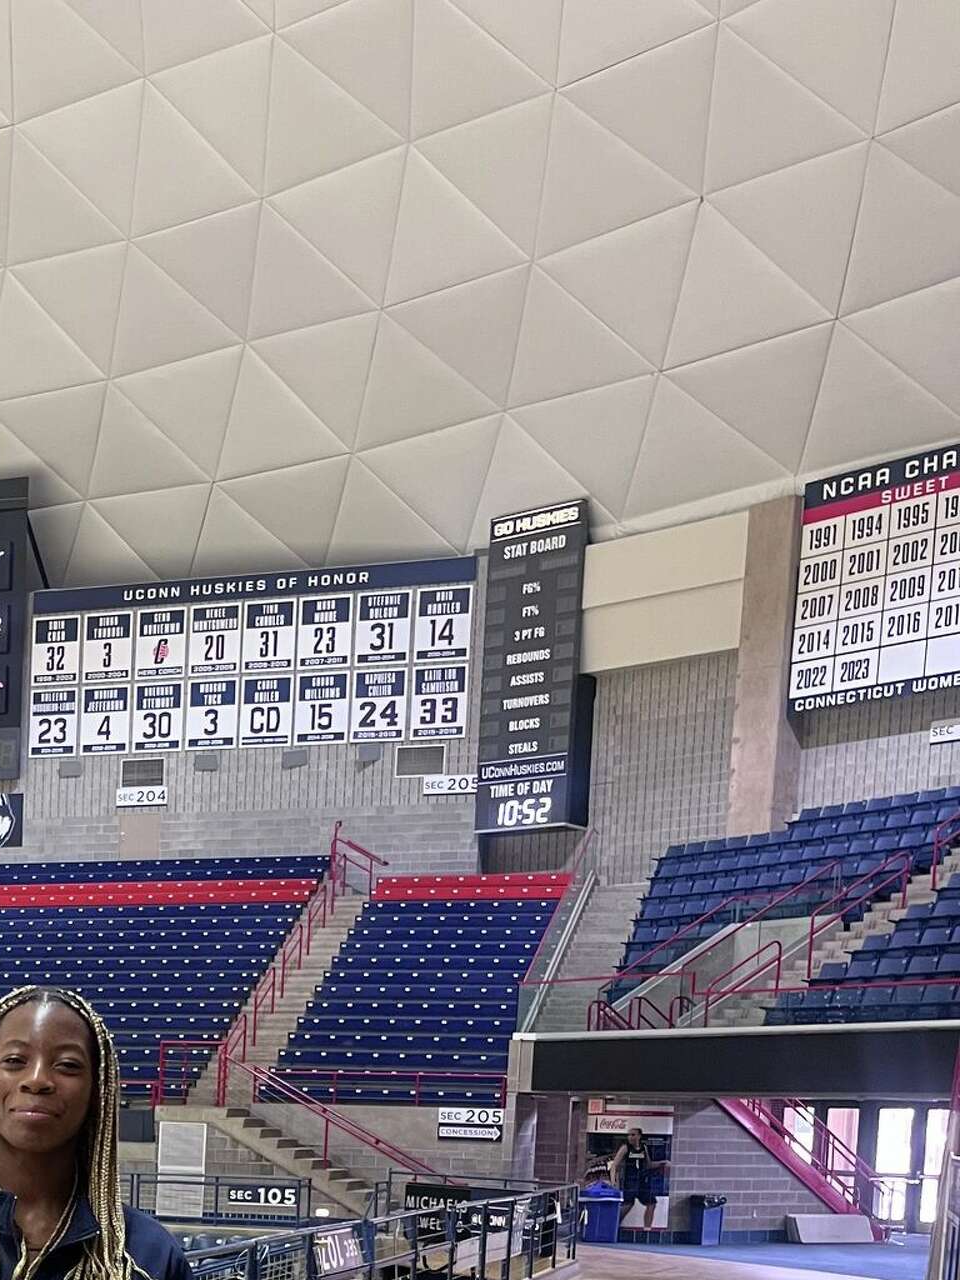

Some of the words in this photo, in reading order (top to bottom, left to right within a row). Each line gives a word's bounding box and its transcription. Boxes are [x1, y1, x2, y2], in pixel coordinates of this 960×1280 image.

[823, 468, 890, 500] NCAA
[881, 476, 949, 504] SWEET
[494, 521, 514, 537] GO
[516, 507, 579, 532] HUSKIES
[810, 524, 837, 550] 1991
[852, 513, 882, 540] 1994
[897, 502, 929, 530] 1995
[504, 543, 528, 560] STAT
[530, 535, 566, 555] BOARD
[804, 559, 837, 585] 2000
[849, 549, 881, 576] 2001
[893, 538, 928, 566] 2002
[124, 585, 181, 601] UCONN
[190, 579, 267, 597] HUSKIES
[276, 576, 298, 591] OF
[308, 571, 370, 587] HONOR
[522, 582, 541, 594] FG%
[801, 595, 833, 620] 2007
[845, 585, 879, 611] 2008
[890, 574, 925, 602] 2009
[522, 605, 539, 618] FT%
[259, 630, 278, 658] 31
[313, 626, 336, 655] 23
[369, 622, 394, 651] 31
[430, 618, 454, 647] 14
[514, 631, 521, 642] 3
[522, 629, 533, 640] PT
[534, 627, 545, 638] FG
[798, 629, 830, 655] 2014
[842, 620, 874, 646] 2015
[888, 611, 921, 638] 2016
[46, 646, 65, 671] 32
[103, 642, 112, 668] 3
[204, 634, 225, 661] 20
[506, 649, 551, 665] REBOUNDS
[510, 672, 545, 687] ASSISTS
[797, 665, 827, 690] 2022
[840, 658, 870, 683] 2023
[419, 697, 458, 724] 33
[502, 694, 550, 710] TURNOVERS
[794, 683, 905, 712] CONNECTICUT
[142, 712, 171, 739] 30
[204, 709, 219, 735] 3
[250, 706, 281, 734] CD
[310, 703, 333, 731] 15
[358, 700, 398, 728] 24
[509, 718, 540, 732] BLOCKS
[38, 718, 67, 744] 23
[97, 715, 111, 741] 4
[932, 725, 955, 737] SEC
[508, 741, 538, 755] STEALS
[118, 792, 135, 802] SEC
[136, 790, 167, 803] 204
[425, 781, 444, 790] SEC
[447, 777, 478, 791] 205
[490, 785, 514, 799] TIME
[517, 783, 531, 796] OF
[532, 779, 553, 794] DAY
[497, 797, 552, 827] 10:52
[440, 1111, 462, 1121] SEC
[465, 1109, 502, 1124] 205
[440, 1128, 498, 1137] CONCESSIONS
[229, 1189, 253, 1201] SEC
[257, 1187, 296, 1206] 105
